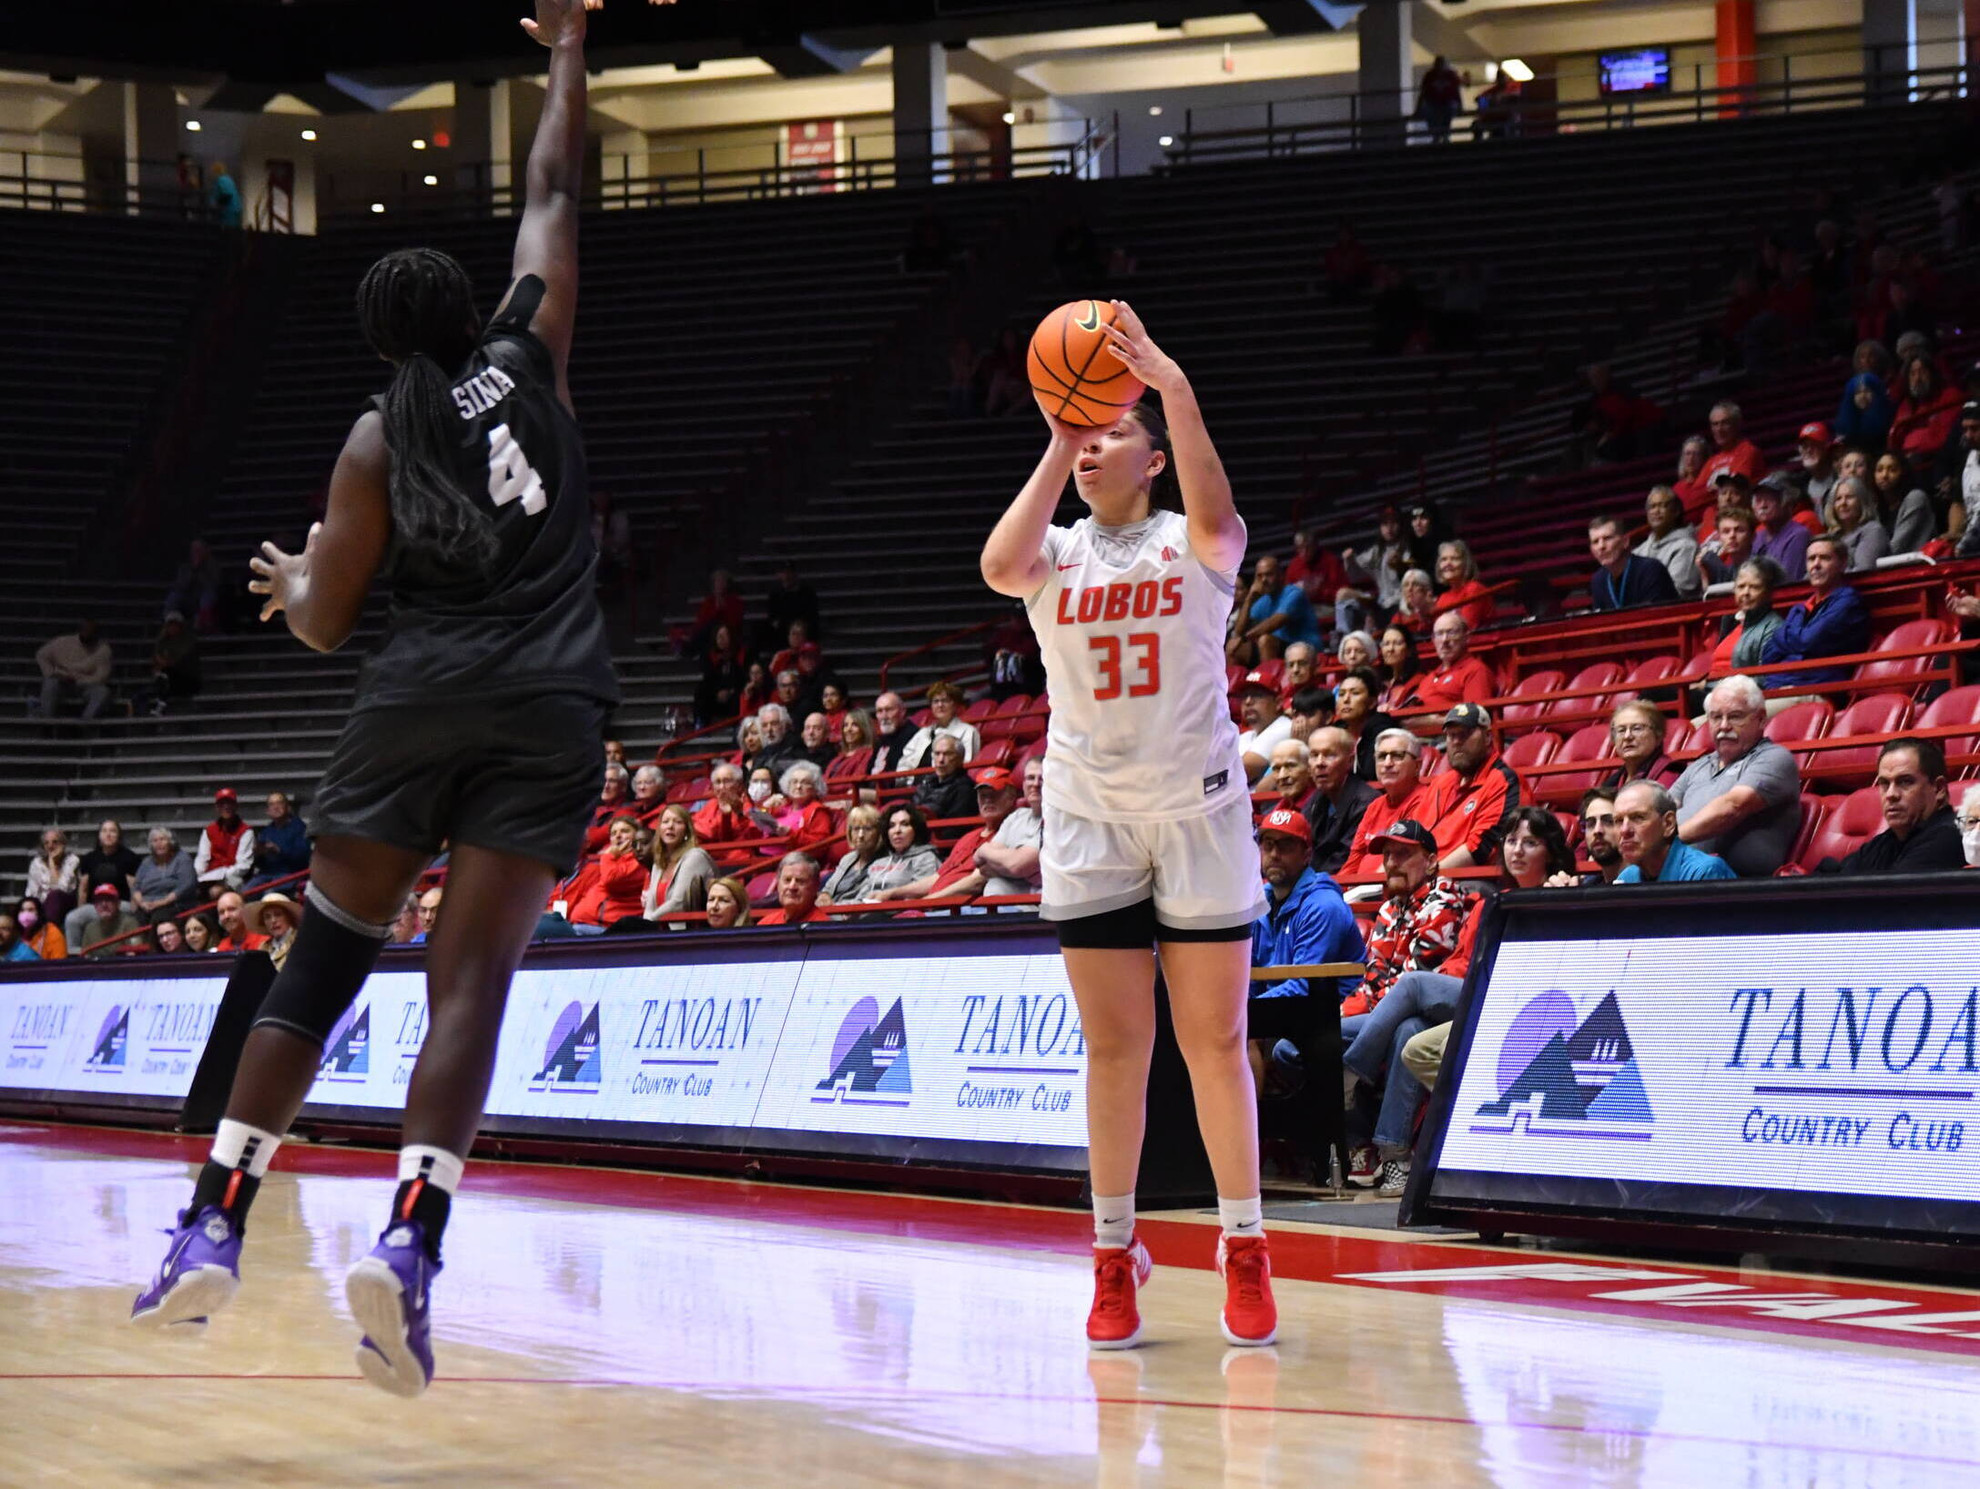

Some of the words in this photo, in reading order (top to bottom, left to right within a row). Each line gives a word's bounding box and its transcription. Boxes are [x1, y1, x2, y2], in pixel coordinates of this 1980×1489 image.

[450, 365, 516, 420] SINA
[487, 422, 548, 516] 4
[1056, 576, 1184, 625] LOBOS
[1088, 632, 1161, 701] 33
[633, 996, 763, 1051] TANOAN
[954, 993, 1085, 1057] TANOA
[1724, 983, 1980, 1075] TANOA
[632, 1071, 680, 1095] COUNTRY
[684, 1072, 714, 1097] CLUB
[957, 1080, 1025, 1109] COUNTRY
[1032, 1082, 1073, 1112] CLUB
[1741, 1105, 1872, 1147] COUNTRY
[1887, 1110, 1965, 1152] CLUB
[1587, 1282, 1980, 1339] VAL
